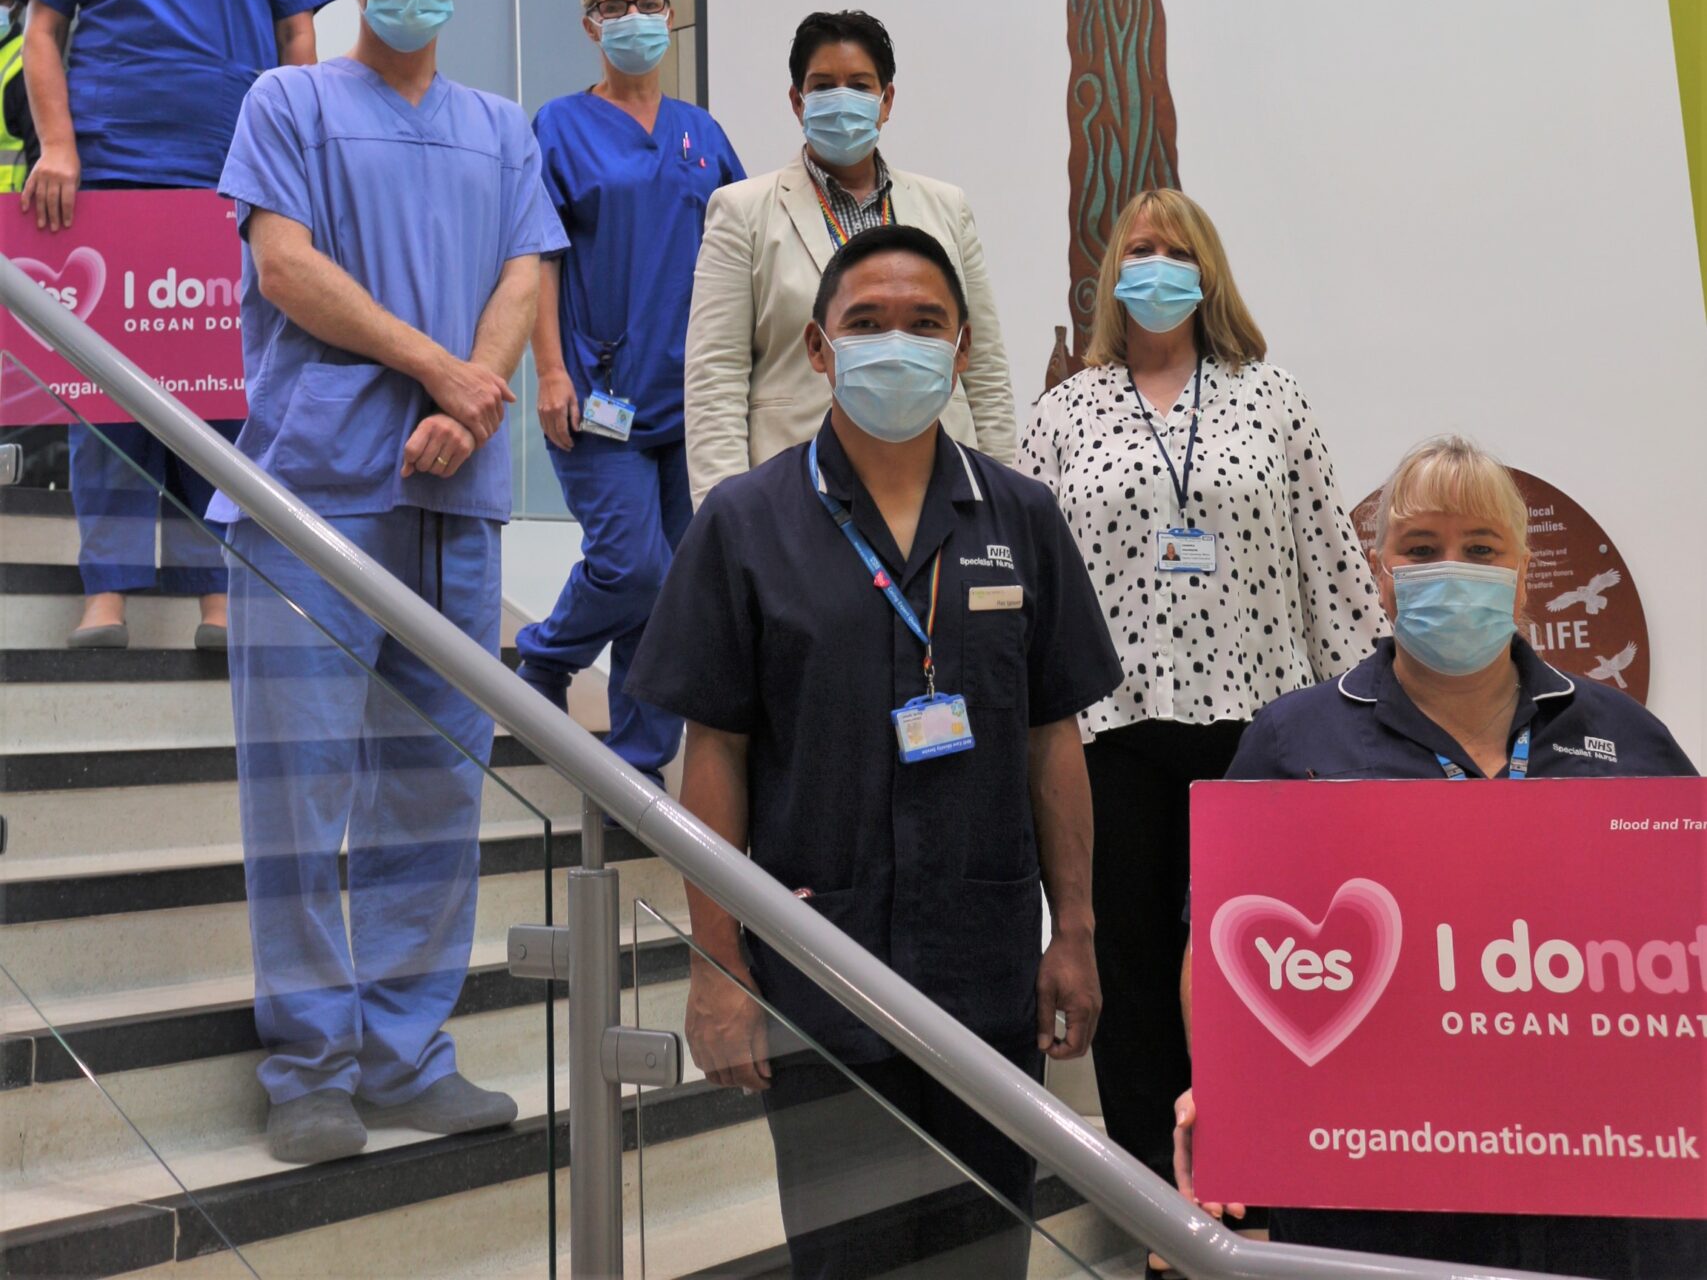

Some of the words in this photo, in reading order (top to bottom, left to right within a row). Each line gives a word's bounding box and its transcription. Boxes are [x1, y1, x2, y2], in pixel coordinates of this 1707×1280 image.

[124, 270, 135, 309] I
[124, 318, 194, 333] ORGAN
[1529, 505, 1554, 517] local
[1527, 521, 1567, 533] amilies.
[1530, 620, 1590, 651] LIFE
[1552, 743, 1591, 758] Specialist
[1595, 753, 1618, 763] Nurse
[1587, 738, 1614, 753] NHS
[1610, 818, 1649, 830] Blood
[1653, 818, 1679, 830] and
[1255, 936, 1354, 991] Yes
[1436, 923, 1456, 992] I
[1442, 1011, 1570, 1036] ORGAN
[1308, 1121, 1700, 1159] organdonation.nhs.uk
